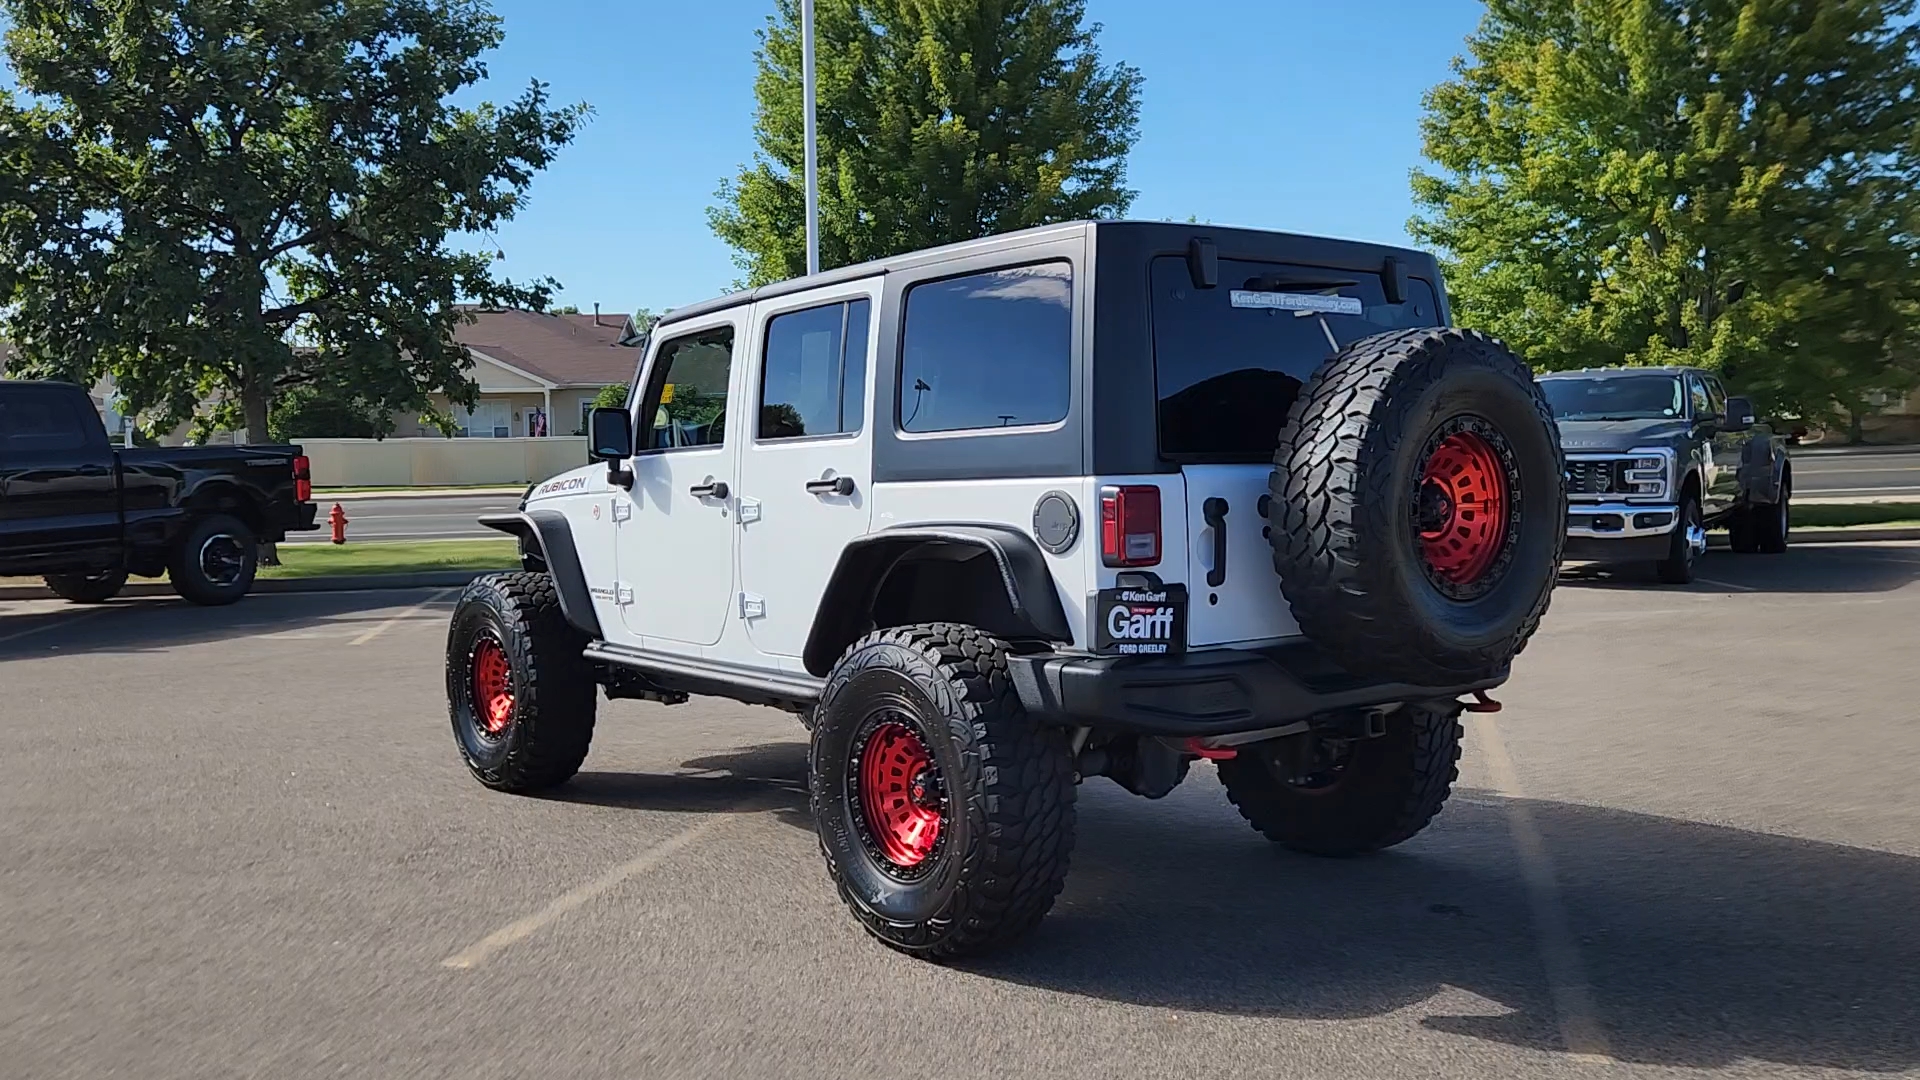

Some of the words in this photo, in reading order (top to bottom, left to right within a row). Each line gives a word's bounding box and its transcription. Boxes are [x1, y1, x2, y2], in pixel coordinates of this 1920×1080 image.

[539, 477, 586, 495] RUBICON
[1108, 605, 1174, 638] Garff
[1119, 644, 1137, 654] FORD
[1138, 644, 1167, 653] GREELEY
